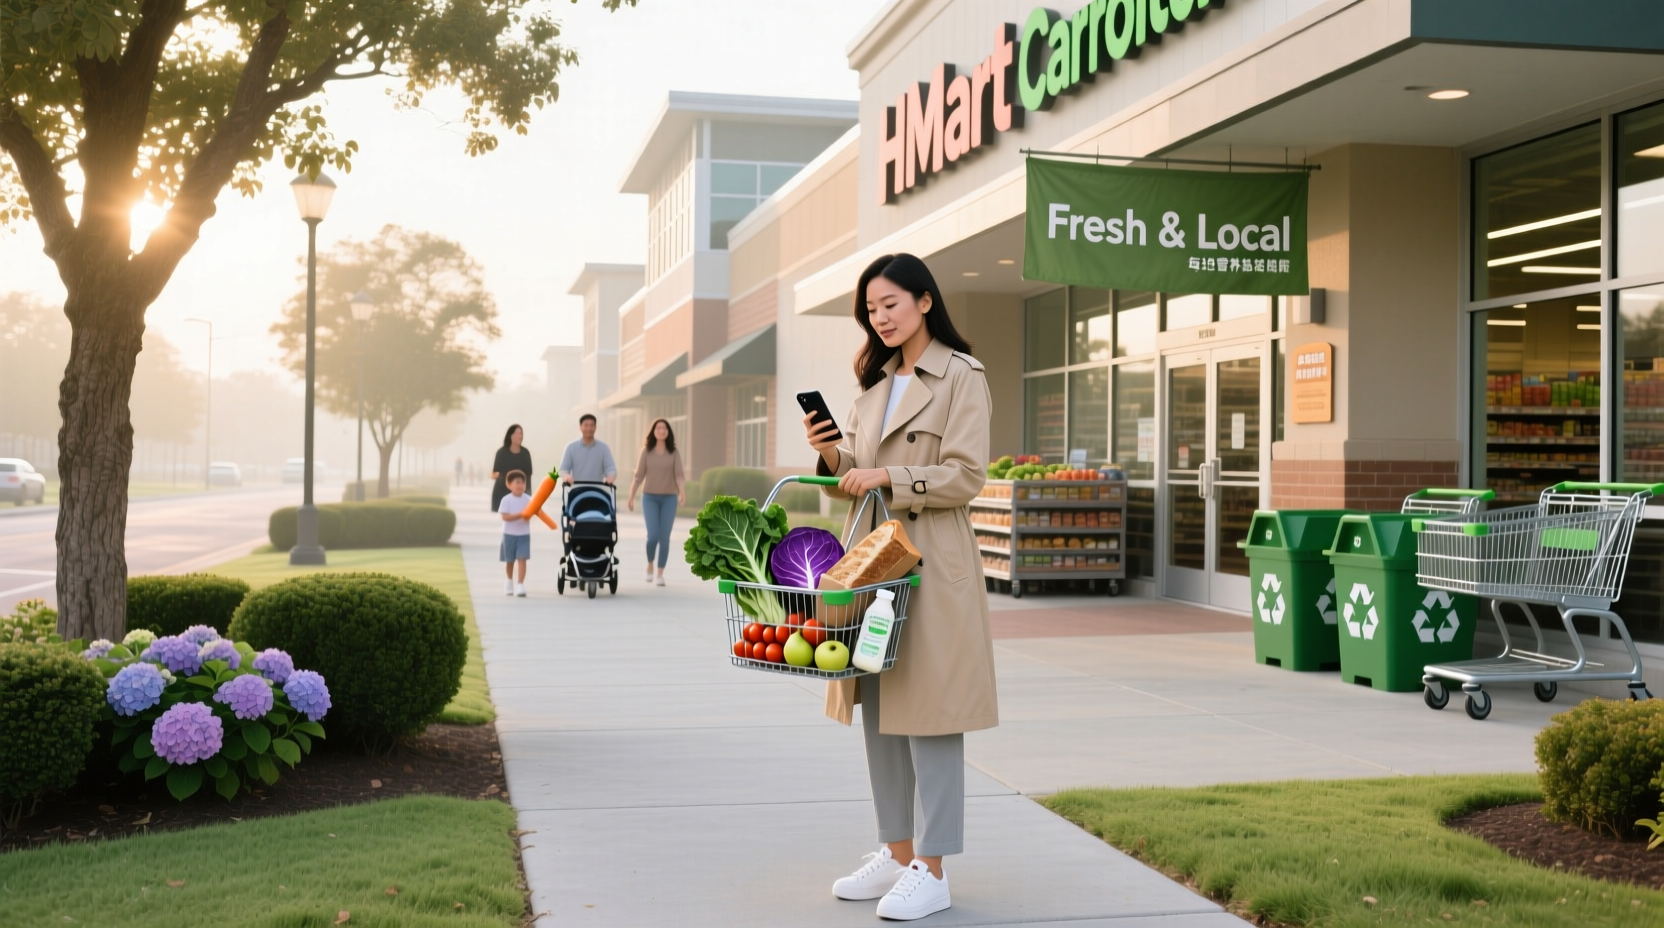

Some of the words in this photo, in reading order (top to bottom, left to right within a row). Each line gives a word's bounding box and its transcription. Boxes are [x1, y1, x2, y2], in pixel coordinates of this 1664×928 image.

[1018, 0, 1210, 111] Carro
[1048, 203, 1147, 246] Fresh
[1158, 211, 1186, 249] &
[1198, 213, 1290, 252] Local
